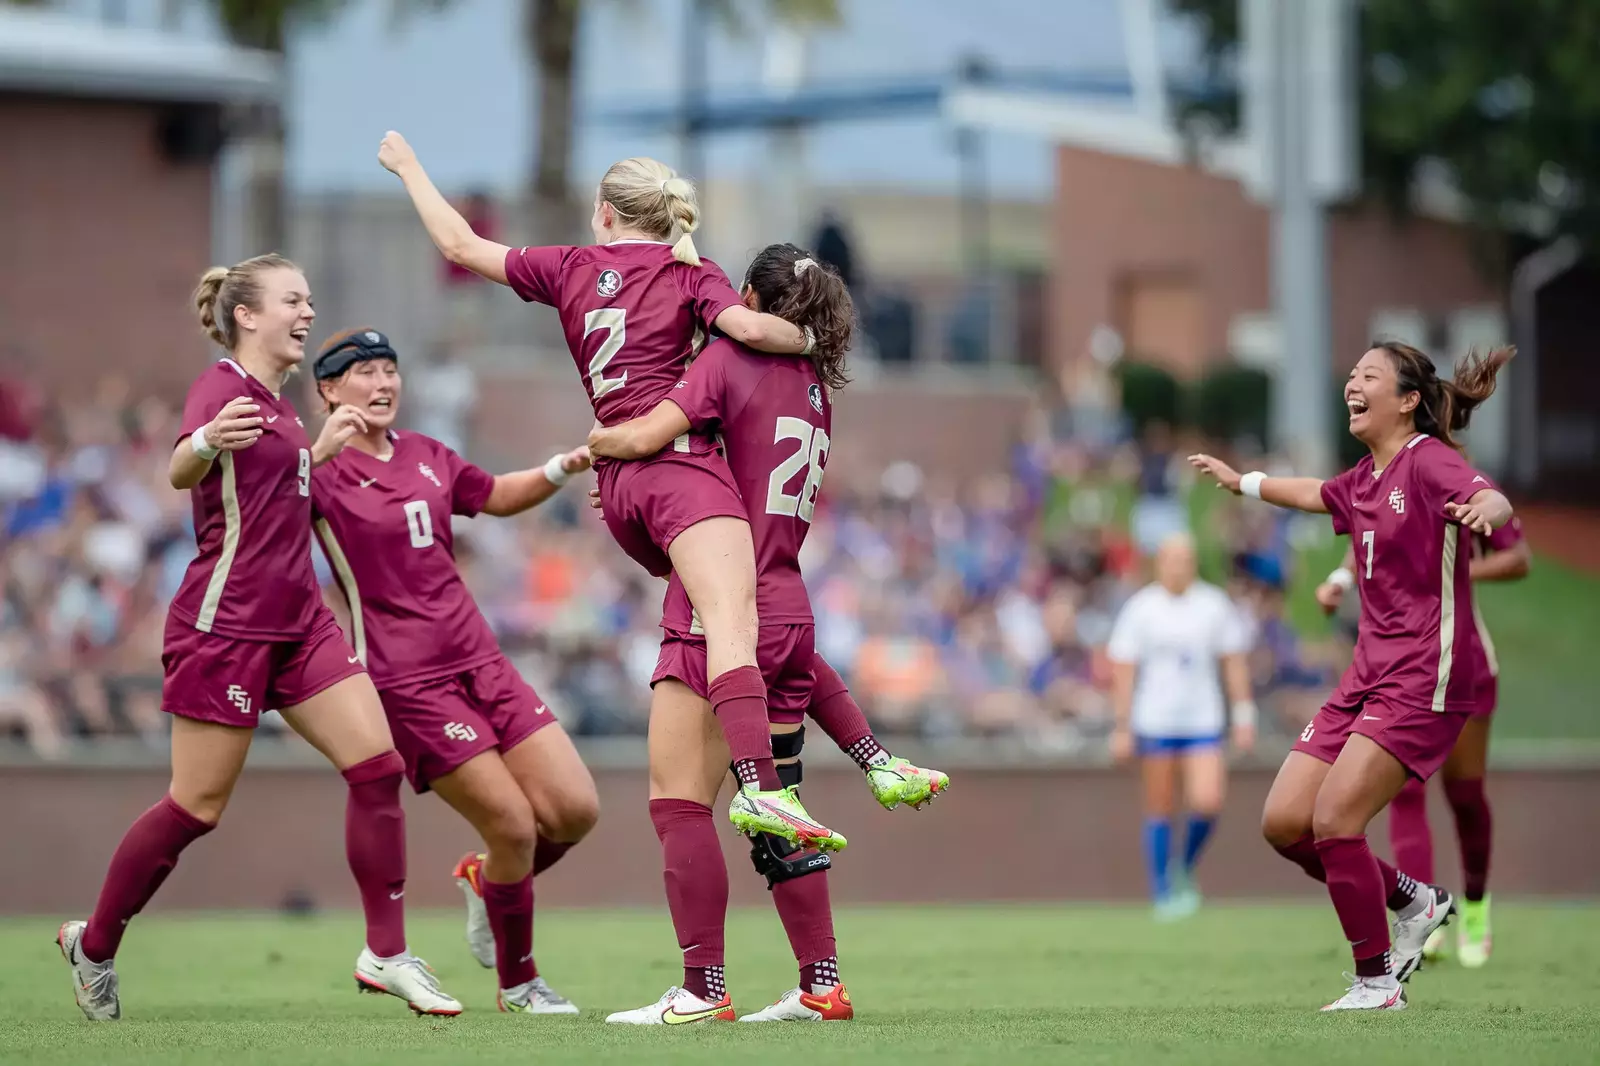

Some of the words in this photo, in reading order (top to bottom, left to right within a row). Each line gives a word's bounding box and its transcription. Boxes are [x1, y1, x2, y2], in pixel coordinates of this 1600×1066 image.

[583, 308, 628, 400] 2
[298, 447, 311, 497] 9
[765, 416, 830, 524] 26
[403, 500, 434, 549] 0
[1362, 530, 1375, 580] 7
[227, 684, 252, 714] FSU
[443, 721, 478, 742] FSU
